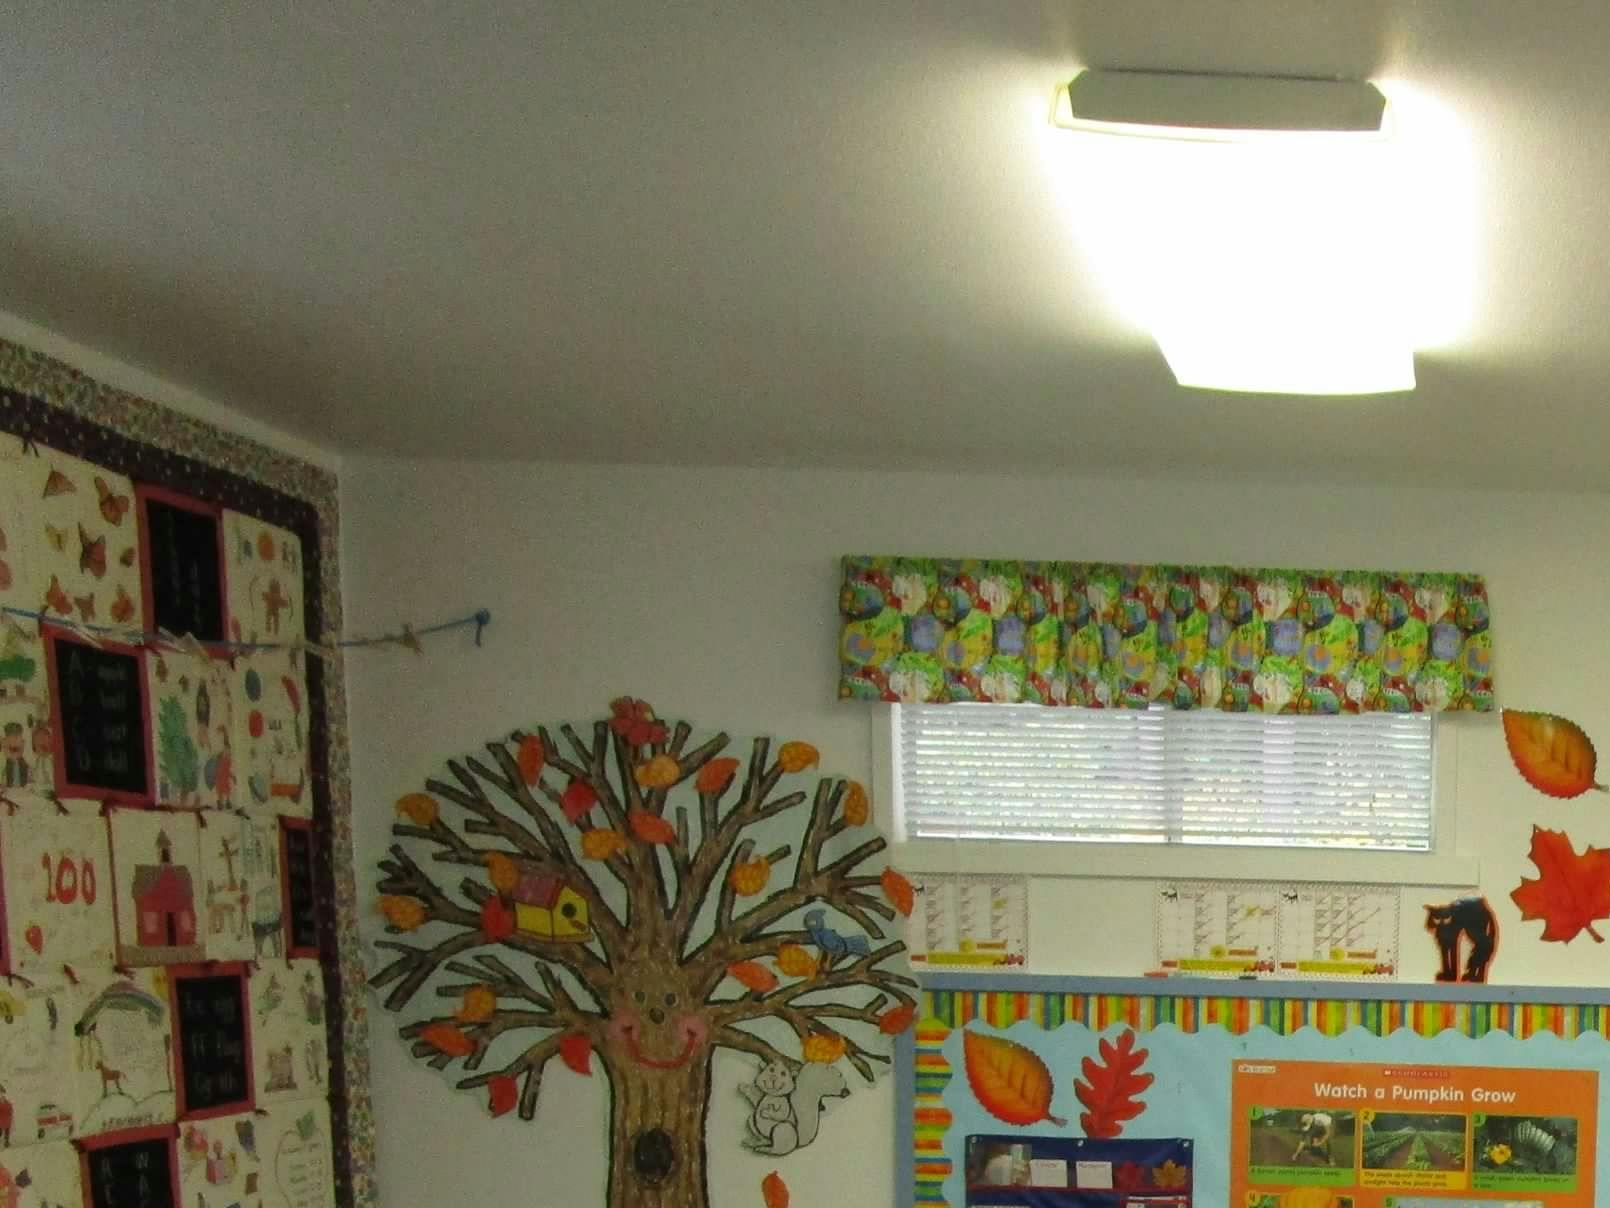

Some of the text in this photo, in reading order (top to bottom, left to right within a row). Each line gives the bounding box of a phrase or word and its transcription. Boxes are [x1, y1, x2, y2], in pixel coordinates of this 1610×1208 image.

[42, 852, 97, 905] 100
[1314, 1083, 1516, 1104] Watch a Pumpkin Grow
